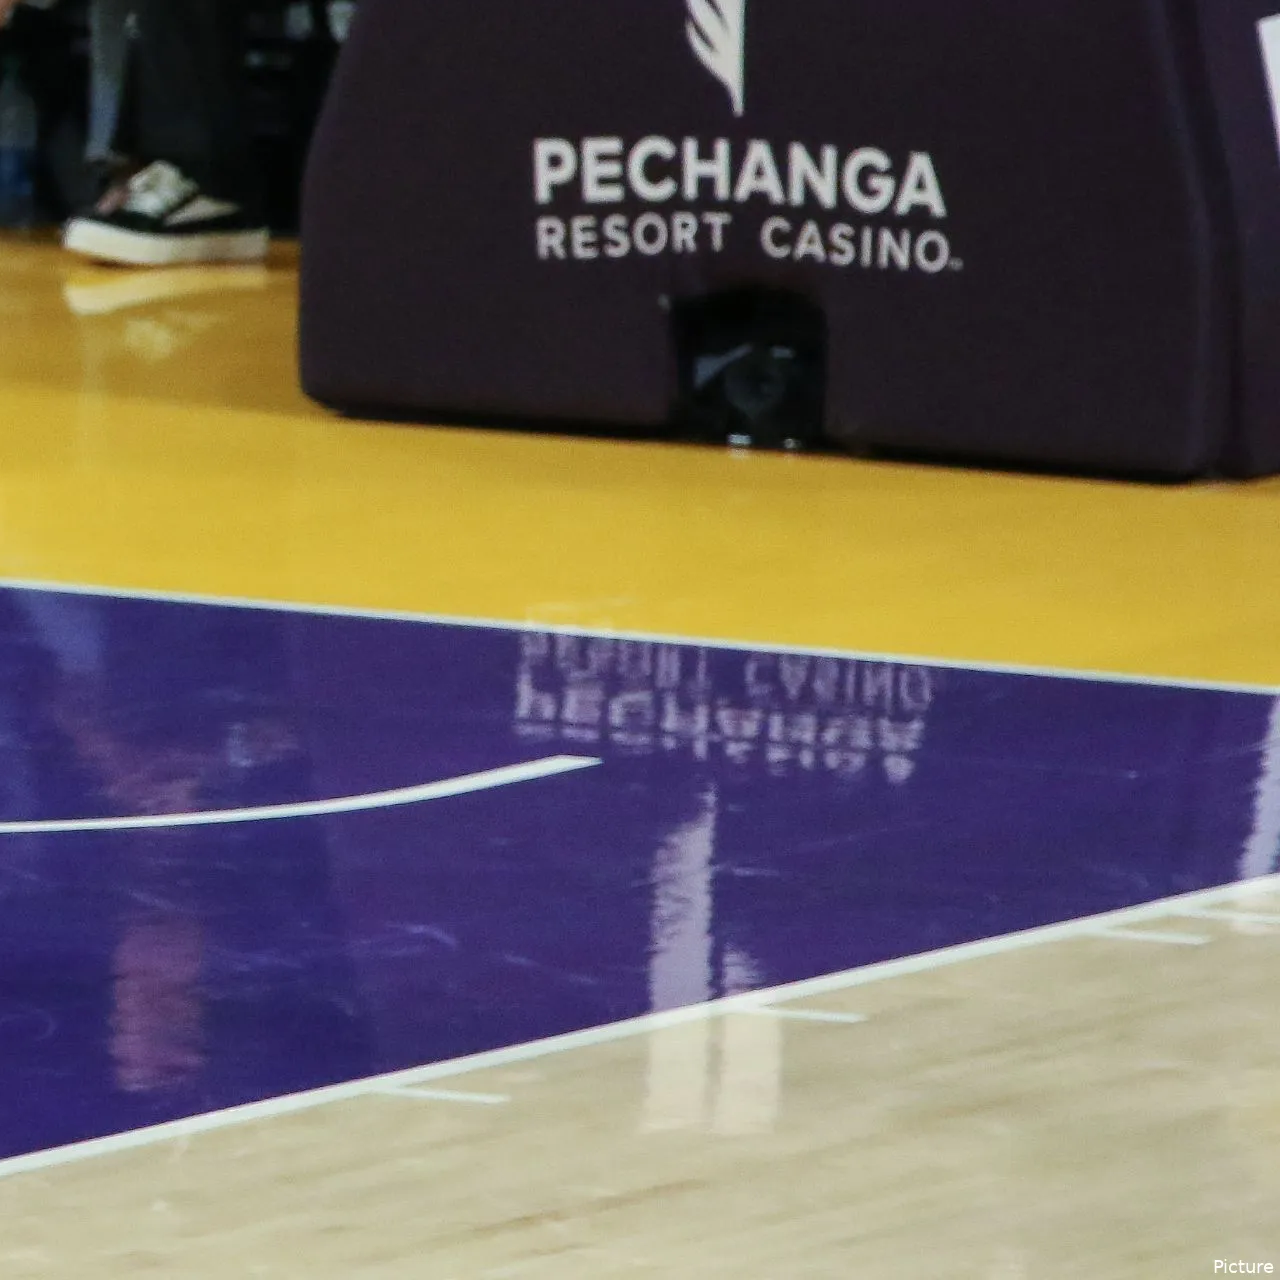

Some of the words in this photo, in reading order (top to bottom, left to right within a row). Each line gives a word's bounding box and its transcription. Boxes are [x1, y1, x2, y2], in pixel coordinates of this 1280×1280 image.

[533, 136, 948, 219] PECHANGA
[535, 211, 732, 260] RESORT
[759, 216, 951, 274] CASINO
